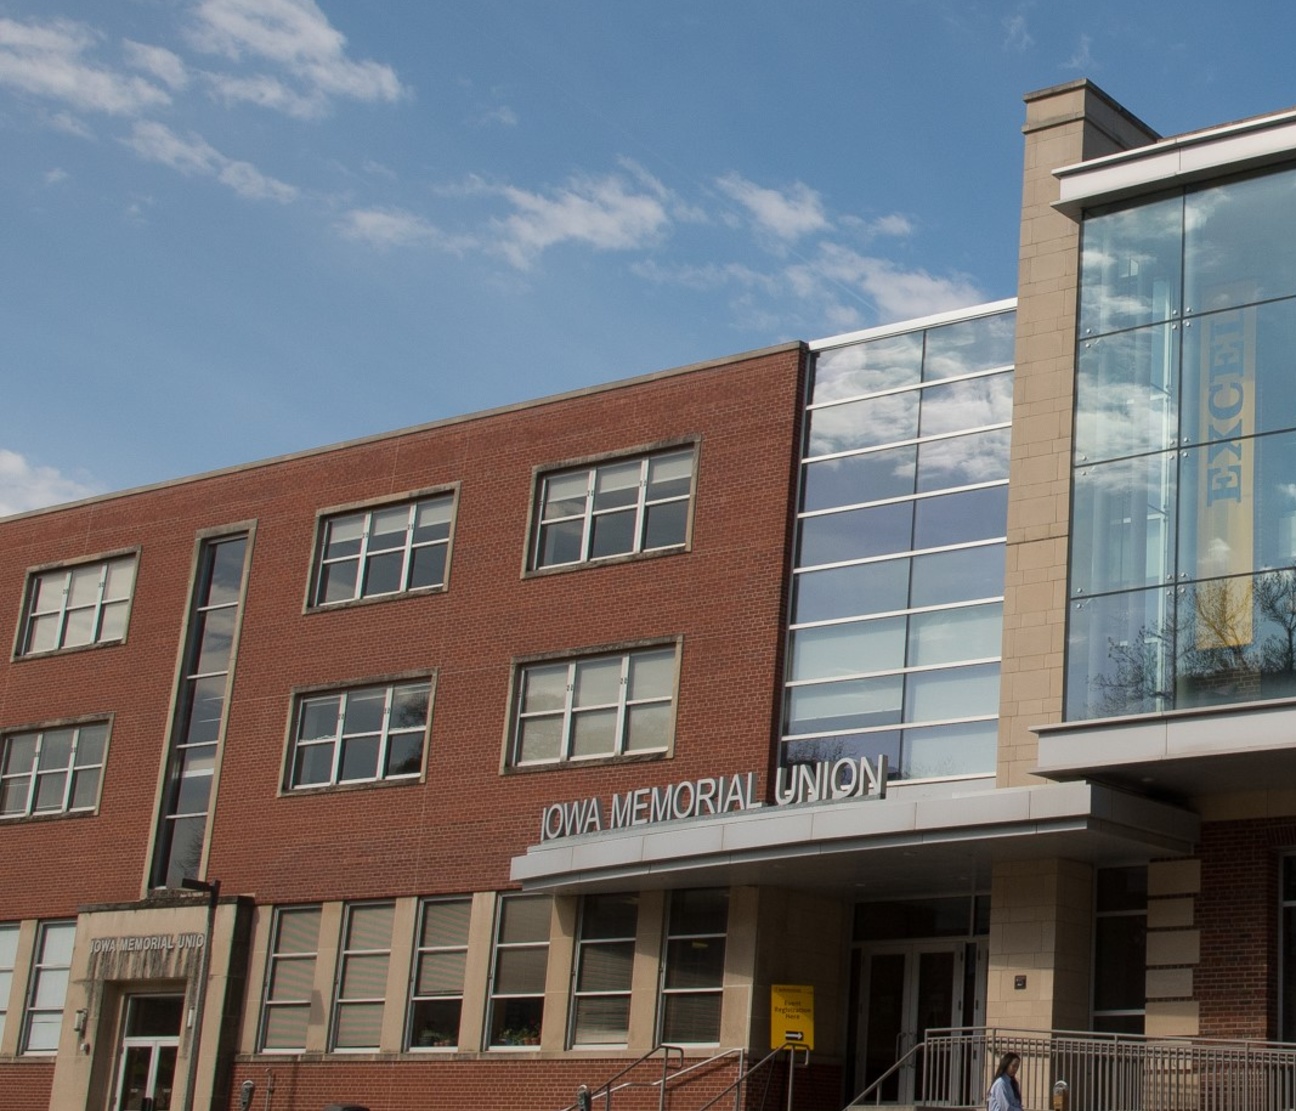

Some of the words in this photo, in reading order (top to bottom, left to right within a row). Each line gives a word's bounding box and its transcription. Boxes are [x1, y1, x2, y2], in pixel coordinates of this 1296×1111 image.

[1206, 304, 1245, 507] EXCEL
[540, 797, 602, 842] IOWA
[610, 772, 764, 830] MEMORIAL
[775, 754, 889, 806] UNION
[90, 939, 116, 954] IOWA
[120, 936, 174, 951] MEMORIAL
[178, 934, 206, 949] UNIO
